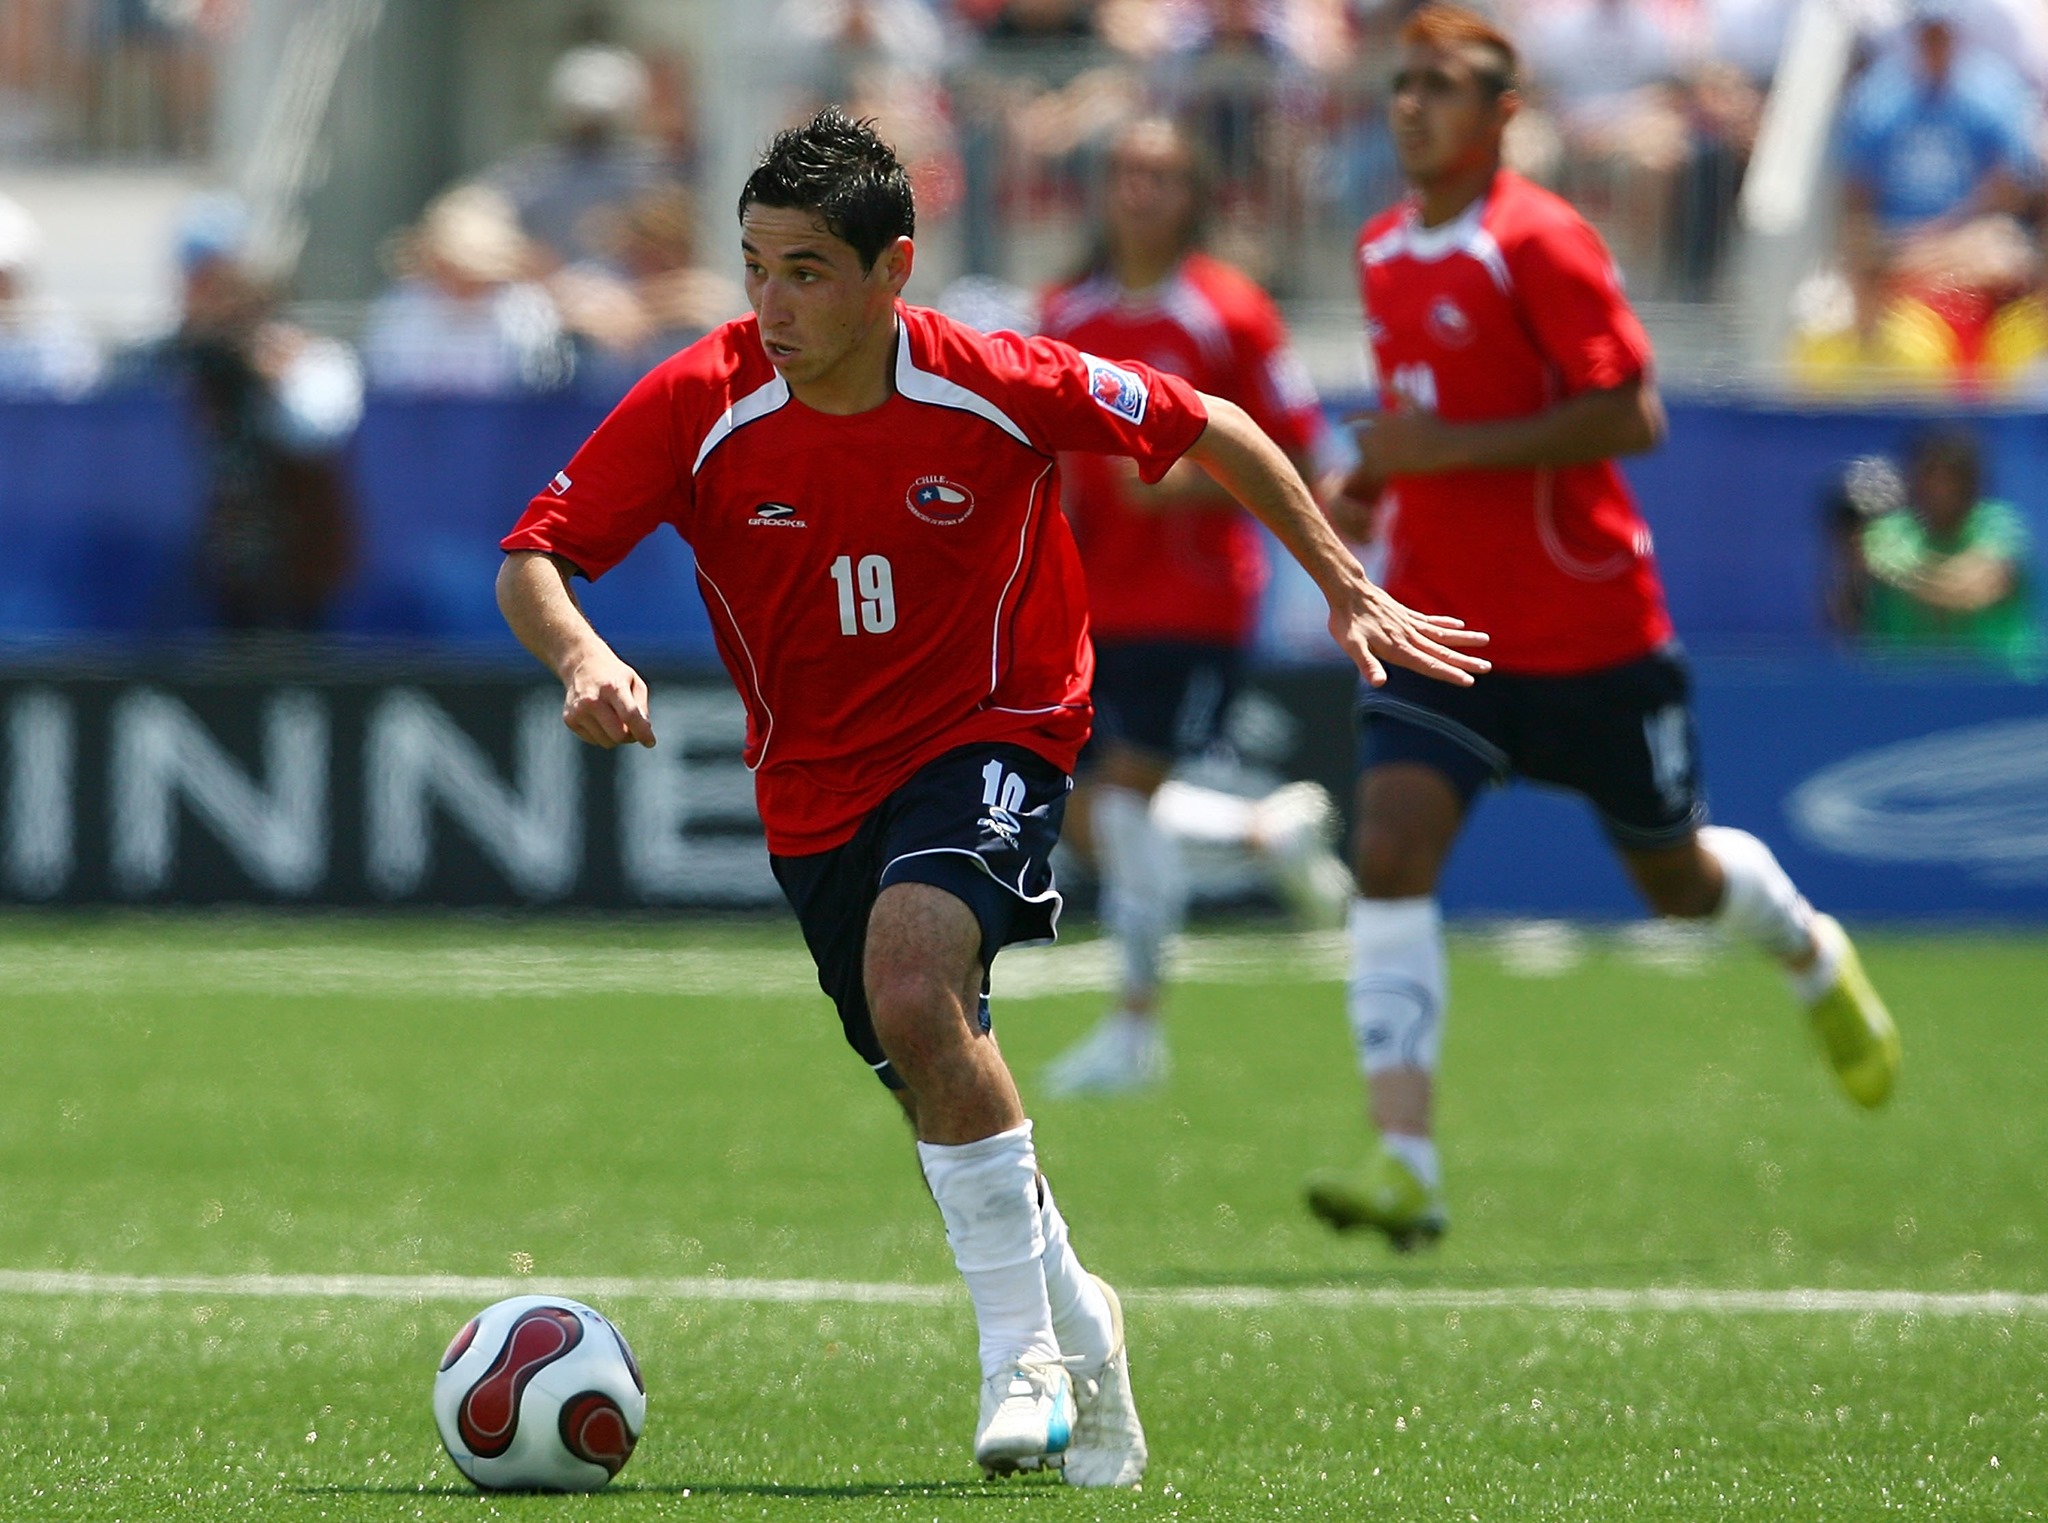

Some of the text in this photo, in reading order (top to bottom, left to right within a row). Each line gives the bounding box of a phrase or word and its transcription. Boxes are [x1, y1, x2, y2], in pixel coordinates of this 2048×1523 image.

[915, 475, 947, 486] CHILE
[748, 517, 806, 529] BROOKS
[830, 554, 896, 636] 19
